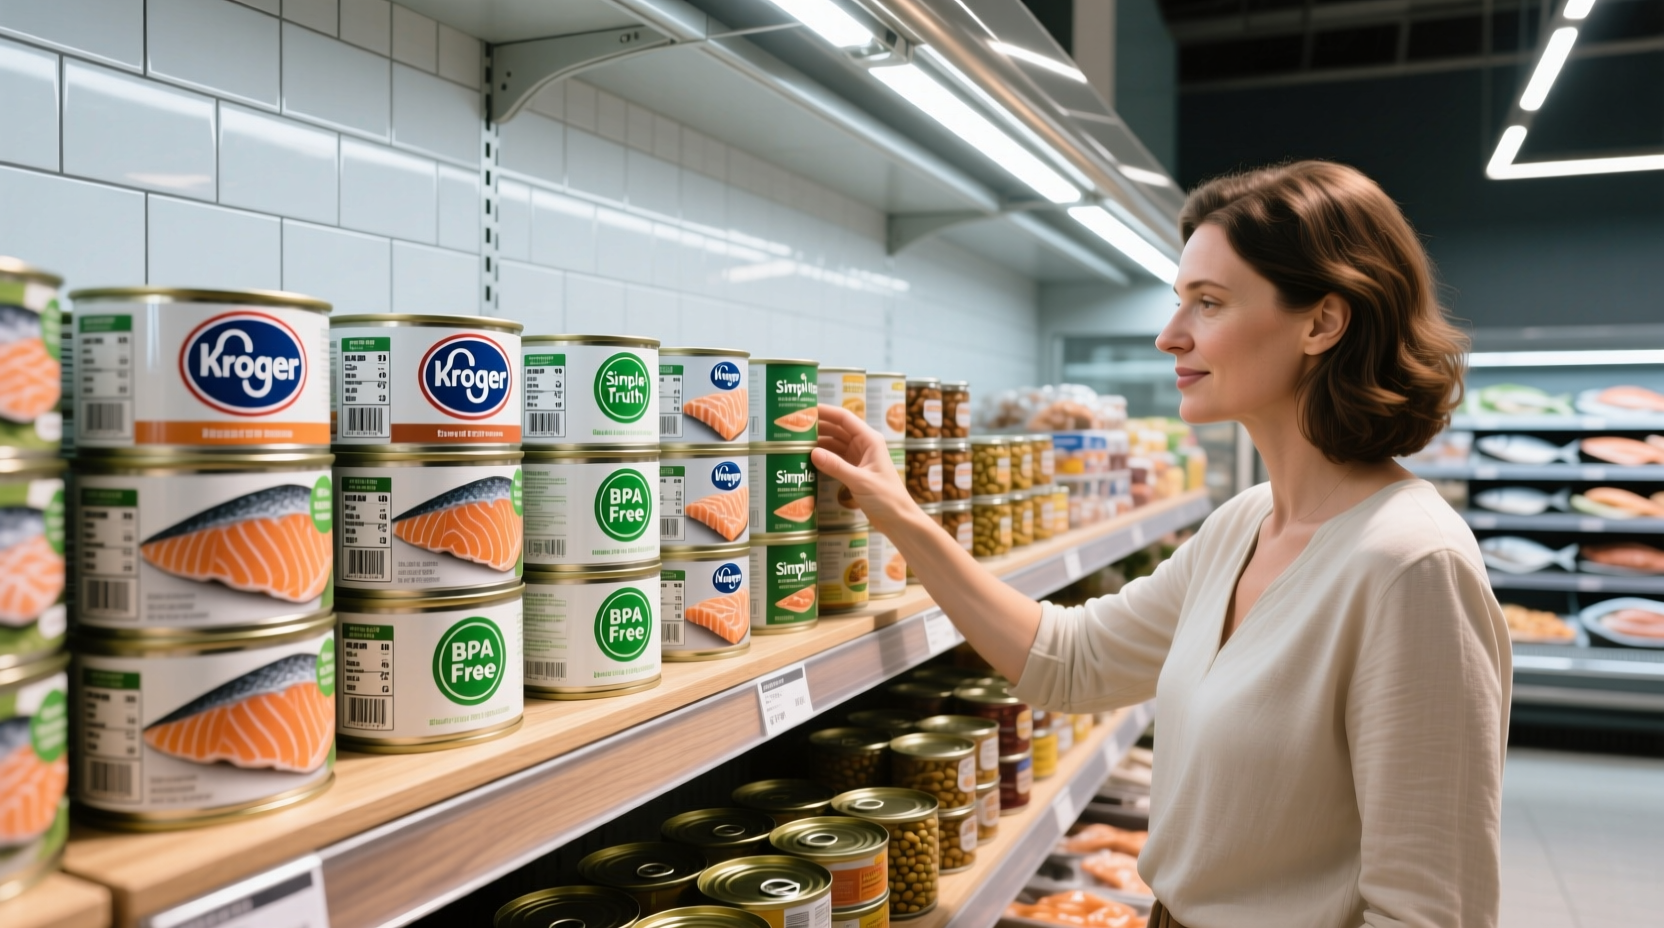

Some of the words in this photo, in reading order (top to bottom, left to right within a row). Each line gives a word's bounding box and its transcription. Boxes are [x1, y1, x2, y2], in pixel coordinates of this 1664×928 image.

[200, 329, 299, 398] Kroger
[434, 348, 507, 404] Kroger
[608, 387, 643, 404] Truth
[609, 487, 643, 504] BPA
[609, 506, 645, 523] Free
[609, 606, 643, 625] BPA
[609, 626, 645, 643] Free
[451, 638, 494, 662] BPA
[451, 662, 497, 683] Free
